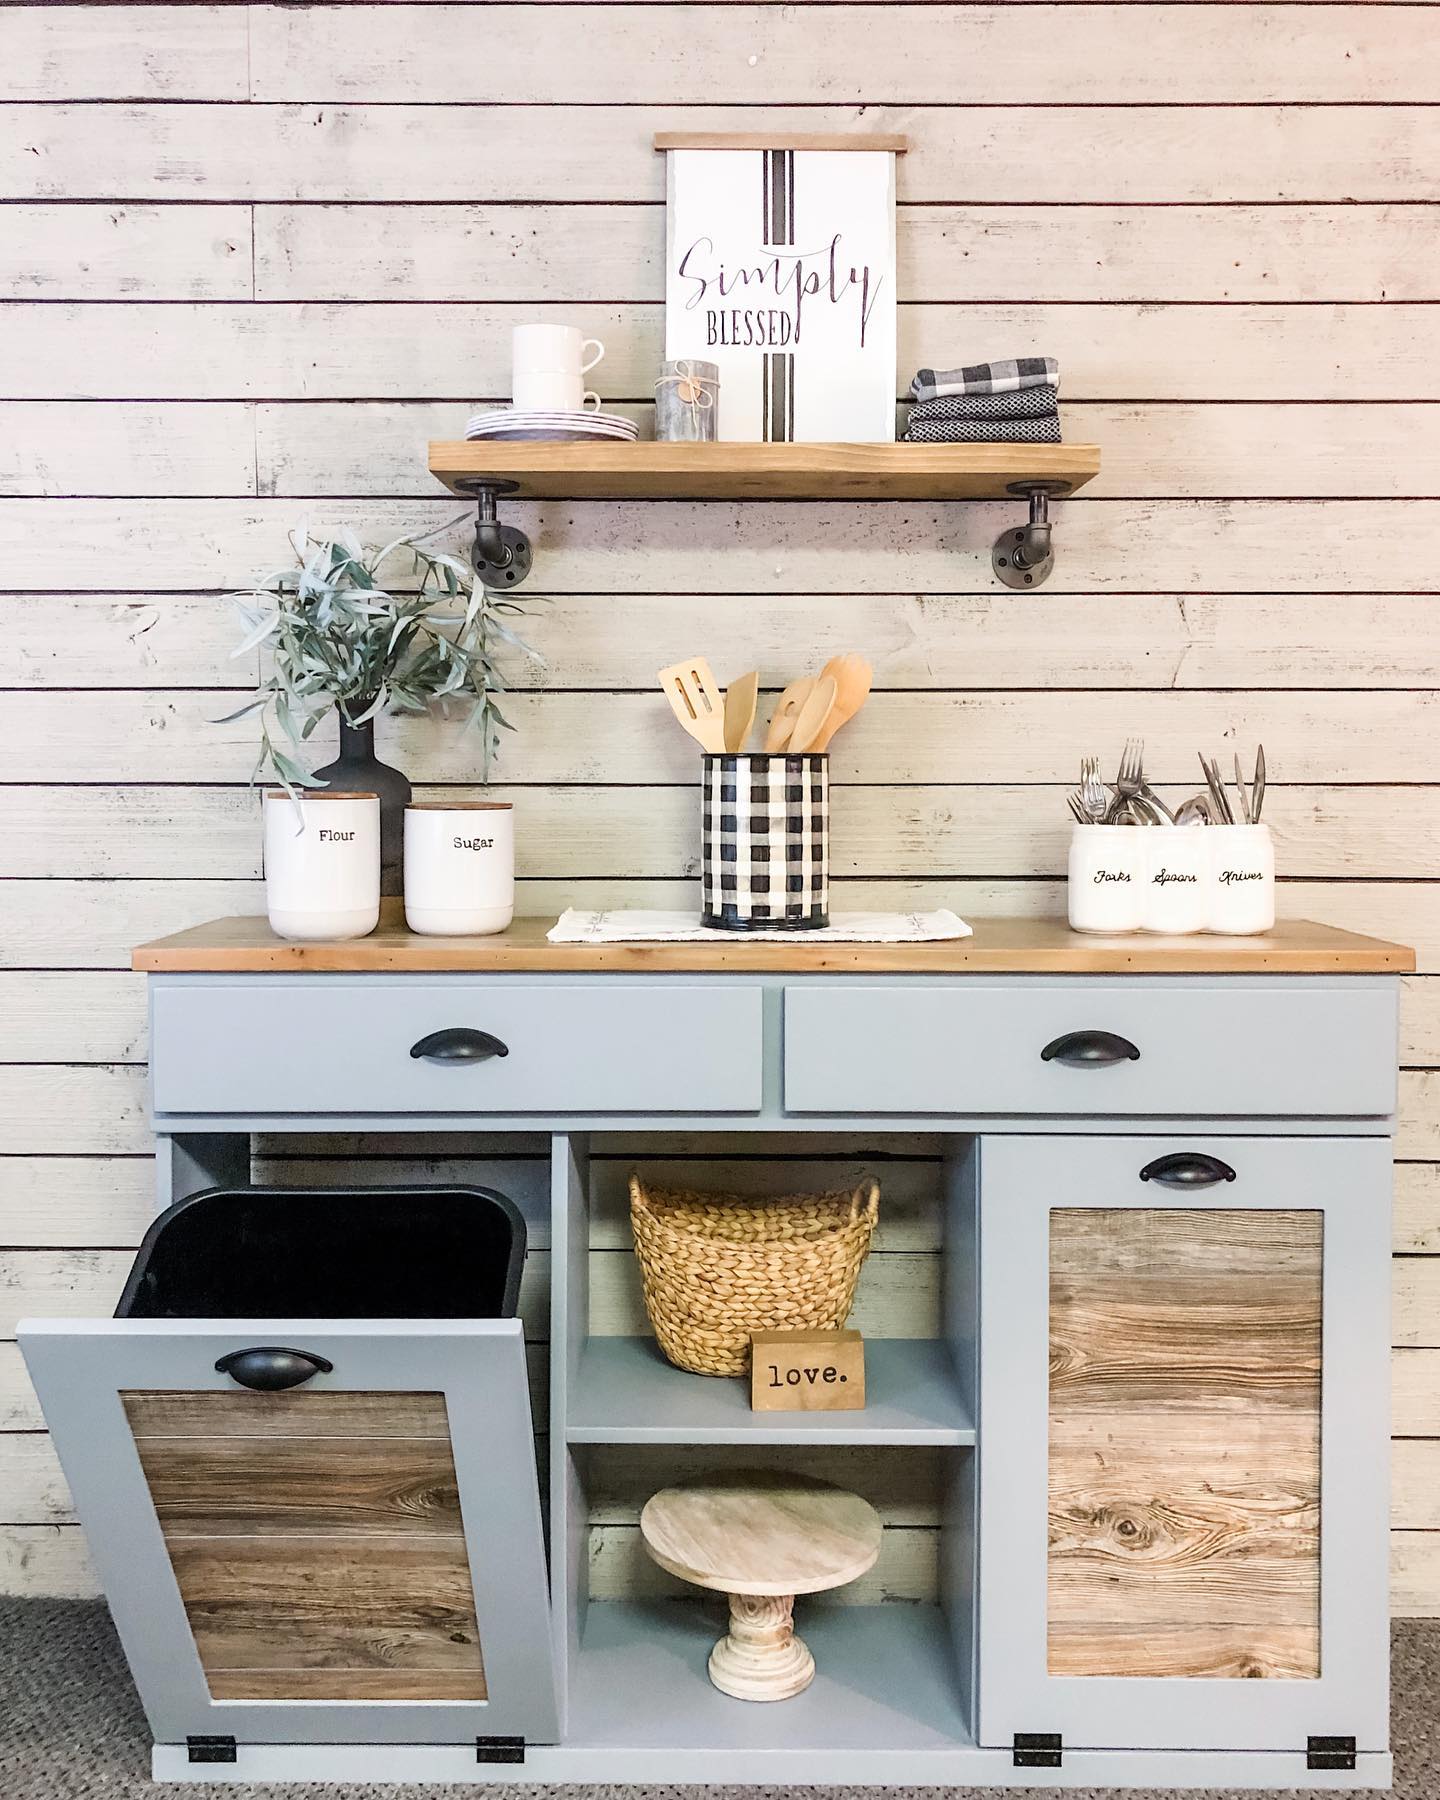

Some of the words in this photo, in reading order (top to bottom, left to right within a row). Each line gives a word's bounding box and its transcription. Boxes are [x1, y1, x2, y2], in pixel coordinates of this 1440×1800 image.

[679, 233, 883, 348] Simply
[706, 309, 792, 346] BLESSED
[319, 829, 356, 842] Flour
[453, 836, 494, 851] Sugar
[1093, 869, 1131, 884] Forks
[1152, 868, 1198, 886] Spoons
[1218, 870, 1264, 885] Knives
[768, 1365, 848, 1387] love.
